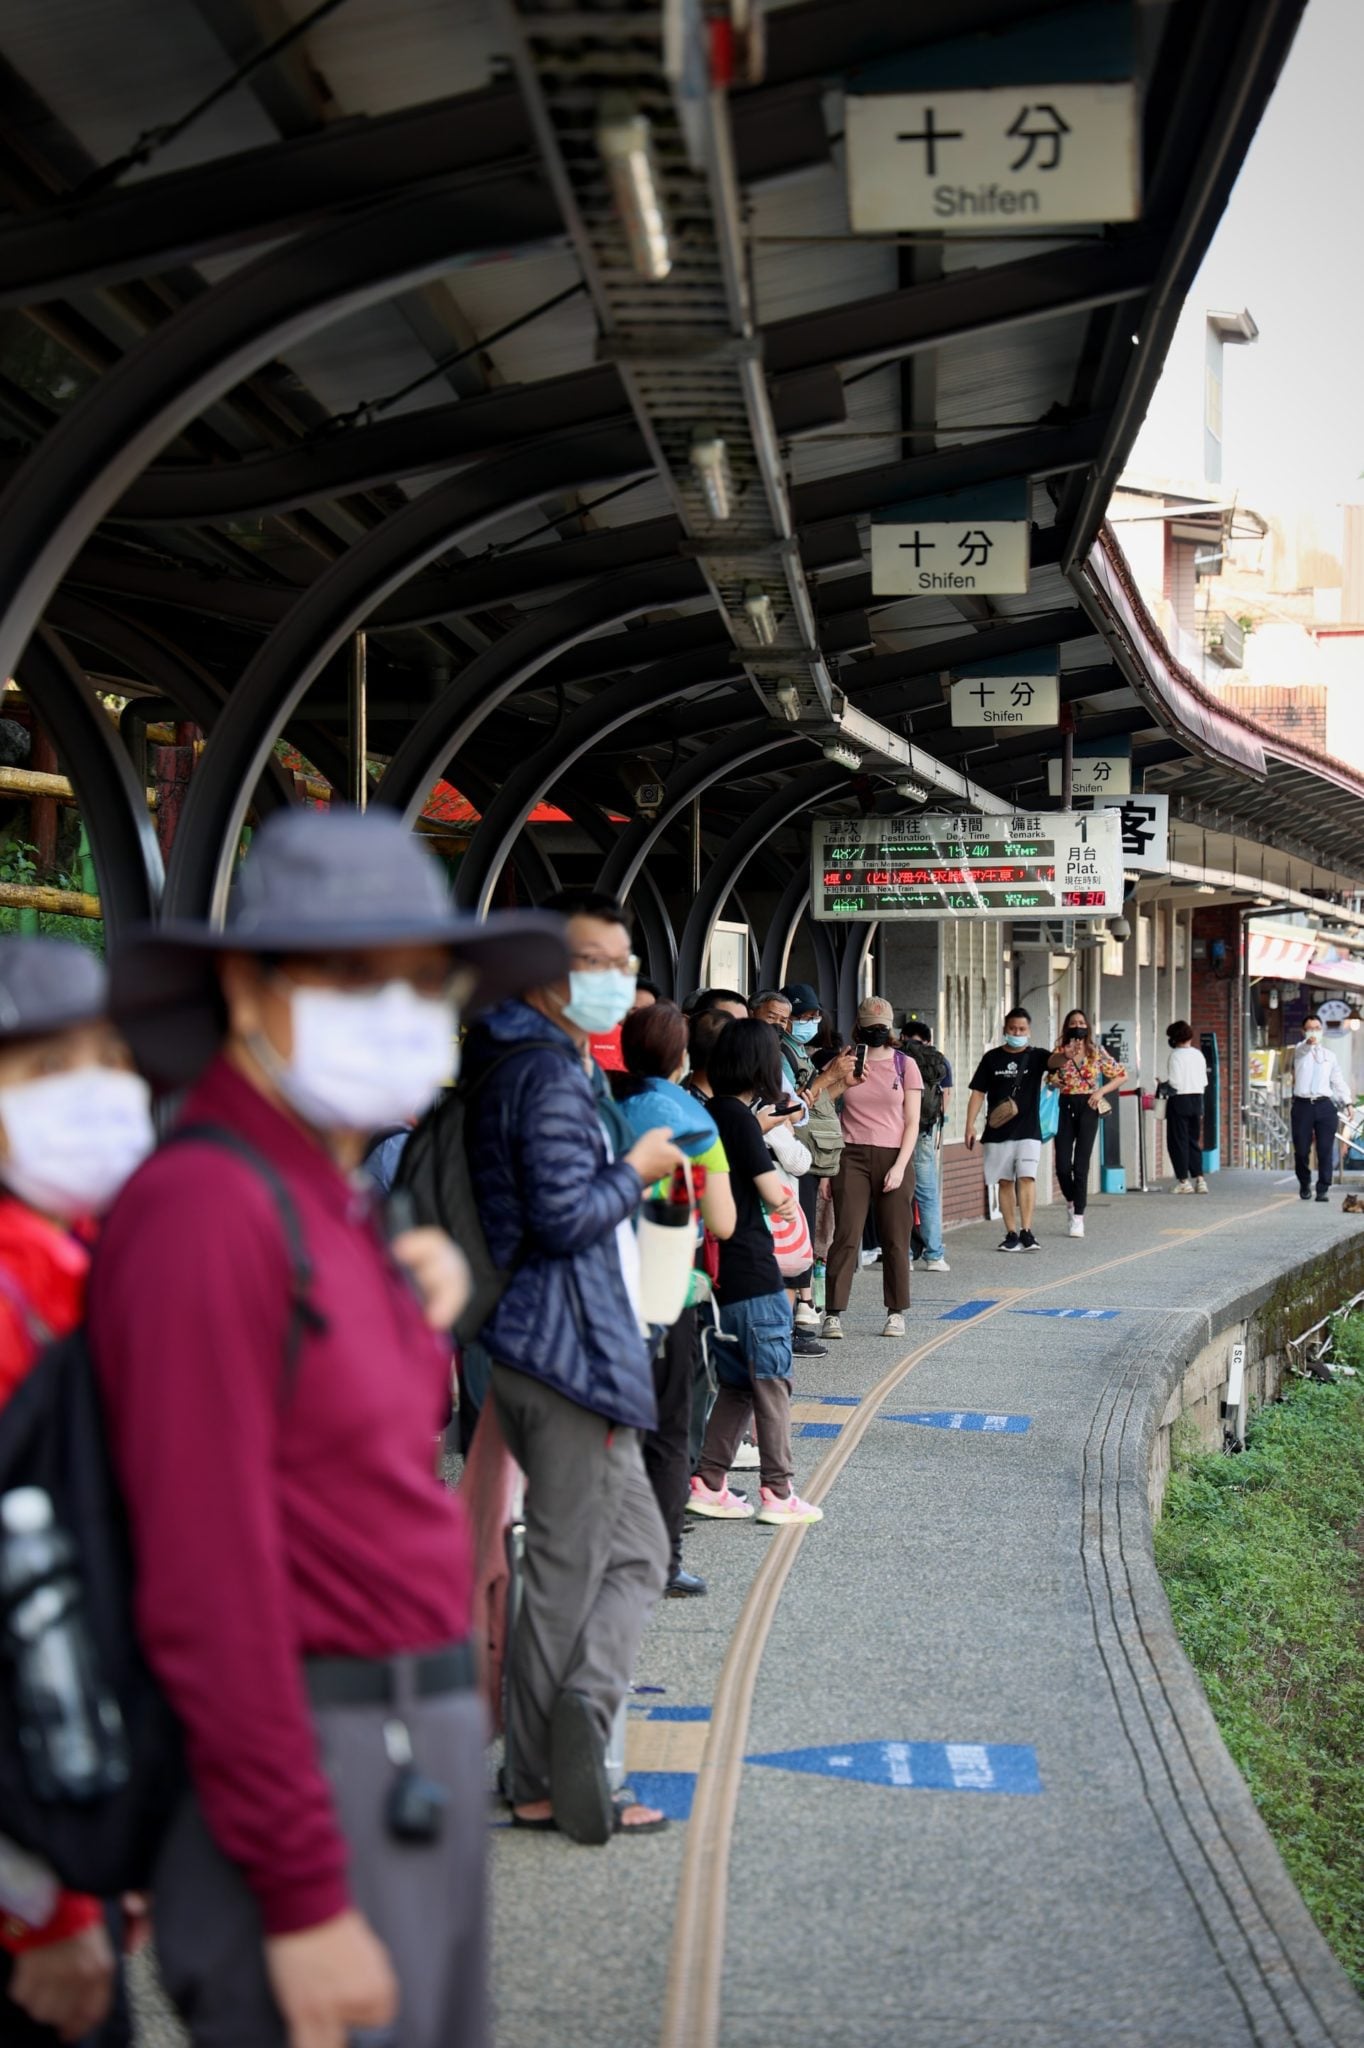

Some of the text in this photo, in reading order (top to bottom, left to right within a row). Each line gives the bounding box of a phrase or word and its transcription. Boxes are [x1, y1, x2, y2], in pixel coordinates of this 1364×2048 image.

[896, 102, 1071, 177] 十分
[933, 184, 1040, 218] Shifen
[898, 530, 993, 567] 十分
[918, 572, 976, 589] Shifen
[969, 682, 1035, 708] 十分
[983, 710, 1023, 722] Shifen
[1072, 783, 1103, 793] Shifen
[830, 816, 1041, 834] 車次 開往 時間 備註
[1075, 816, 1087, 843] 1
[1104, 801, 1156, 855] 客
[824, 835, 846, 843] Train
[881, 834, 931, 842] Destination
[970, 831, 990, 840] Time
[1068, 847, 1096, 861] 月台
[1067, 863, 1098, 874] Plat.
[1065, 876, 1101, 885] 現在時刻
